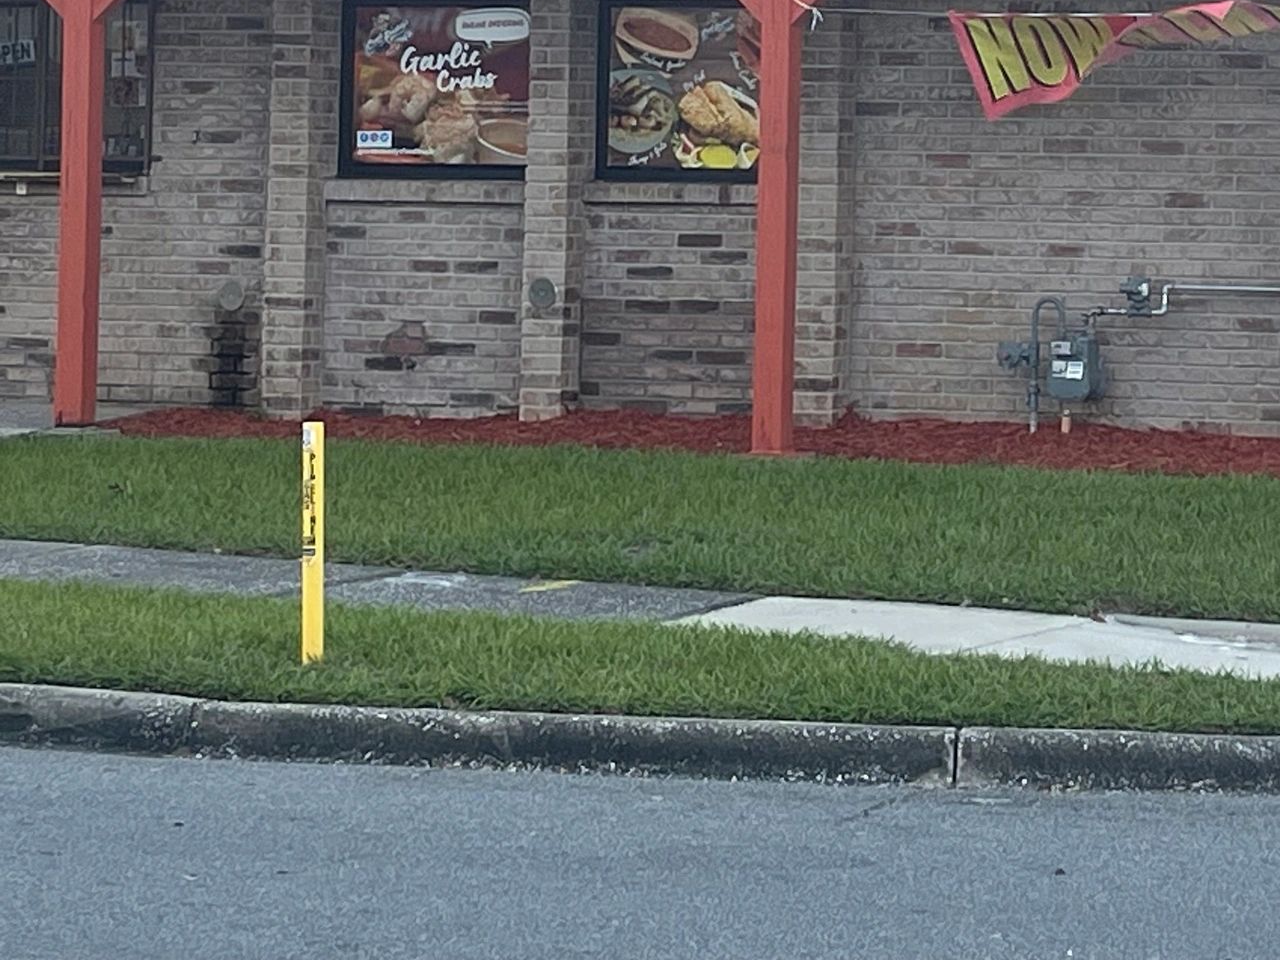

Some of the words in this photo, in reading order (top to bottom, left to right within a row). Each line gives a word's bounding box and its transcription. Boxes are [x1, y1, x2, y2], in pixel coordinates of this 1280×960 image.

[0, 42, 32, 62] PEN
[400, 41, 482, 76] Garlic
[964, 15, 1114, 102] NOW
[436, 68, 497, 92] Crabs
